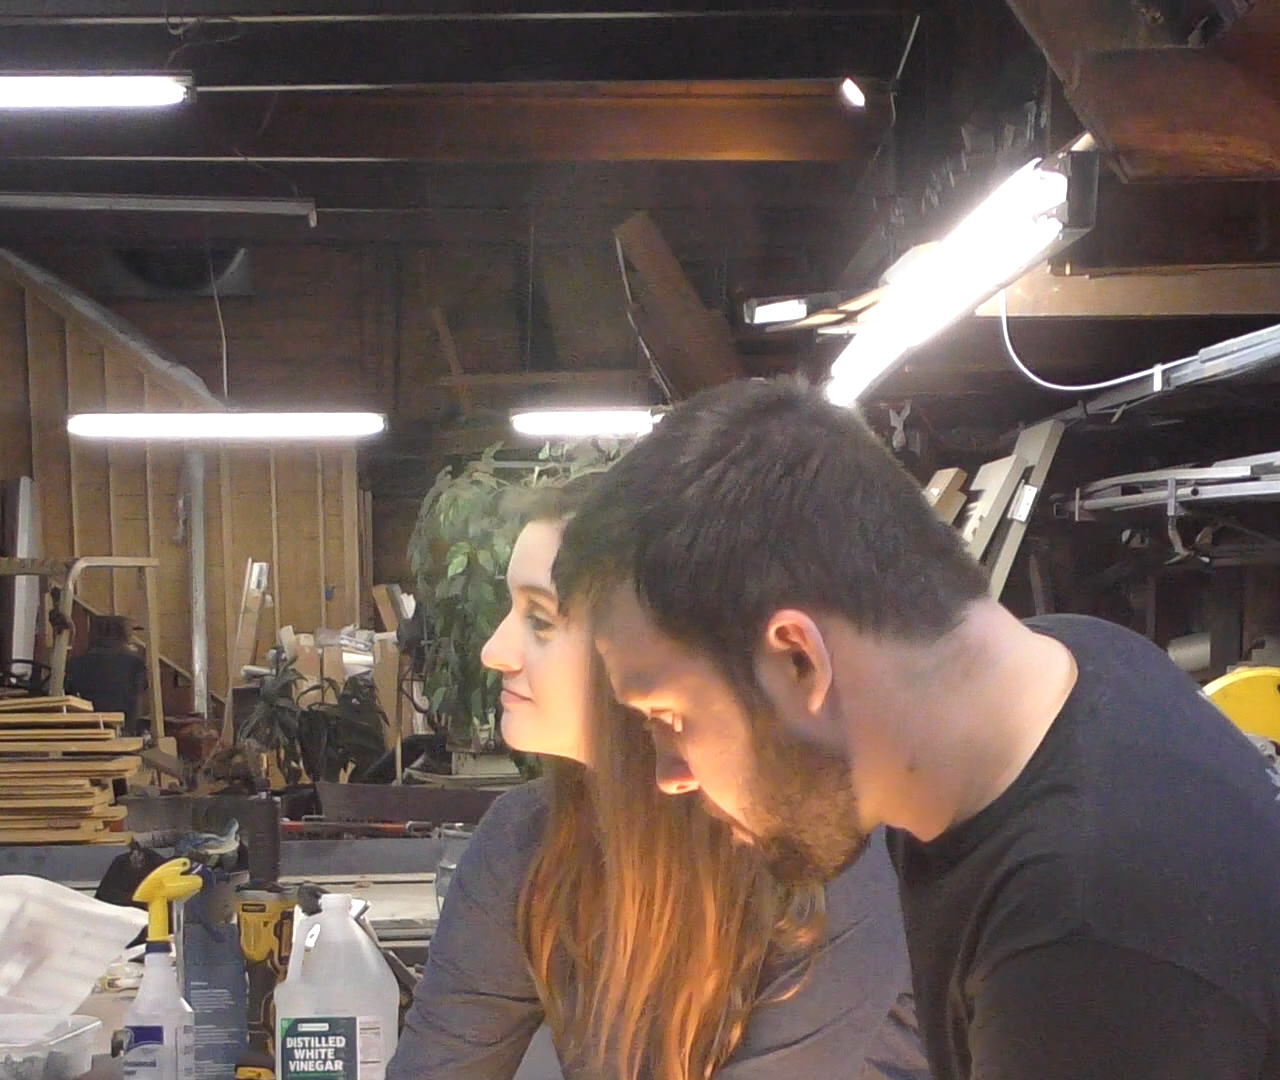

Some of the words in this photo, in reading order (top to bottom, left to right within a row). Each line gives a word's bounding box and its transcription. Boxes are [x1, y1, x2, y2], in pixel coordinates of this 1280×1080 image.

[286, 1036, 346, 1048] DISTILLED
[294, 1048, 335, 1059] WHITE
[288, 1060, 343, 1072] VINEGAR
